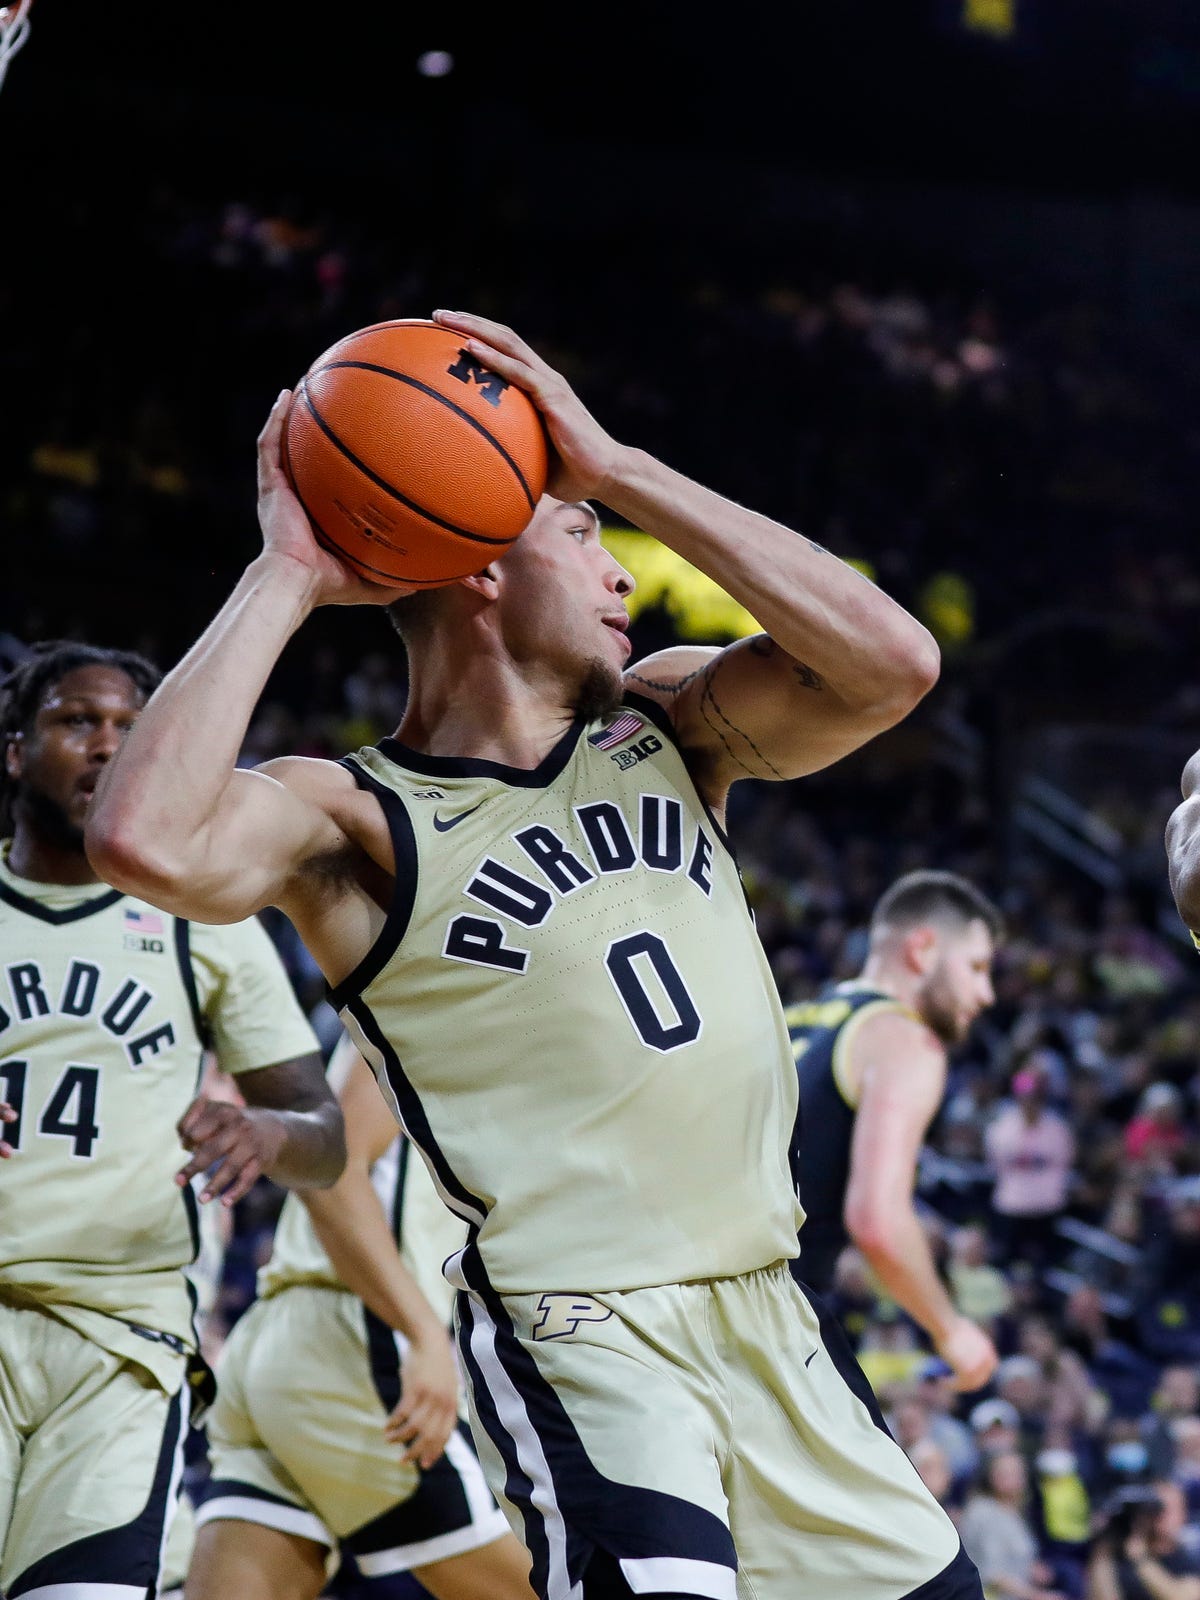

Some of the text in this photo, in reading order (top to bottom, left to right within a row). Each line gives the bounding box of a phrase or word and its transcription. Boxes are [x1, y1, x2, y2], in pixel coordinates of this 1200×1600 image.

[446, 348, 510, 408] M
[441, 792, 715, 976] PURDUE
[603, 928, 704, 1055] 0
[0, 1058, 103, 1162] 14
[532, 1293, 614, 1342] P
